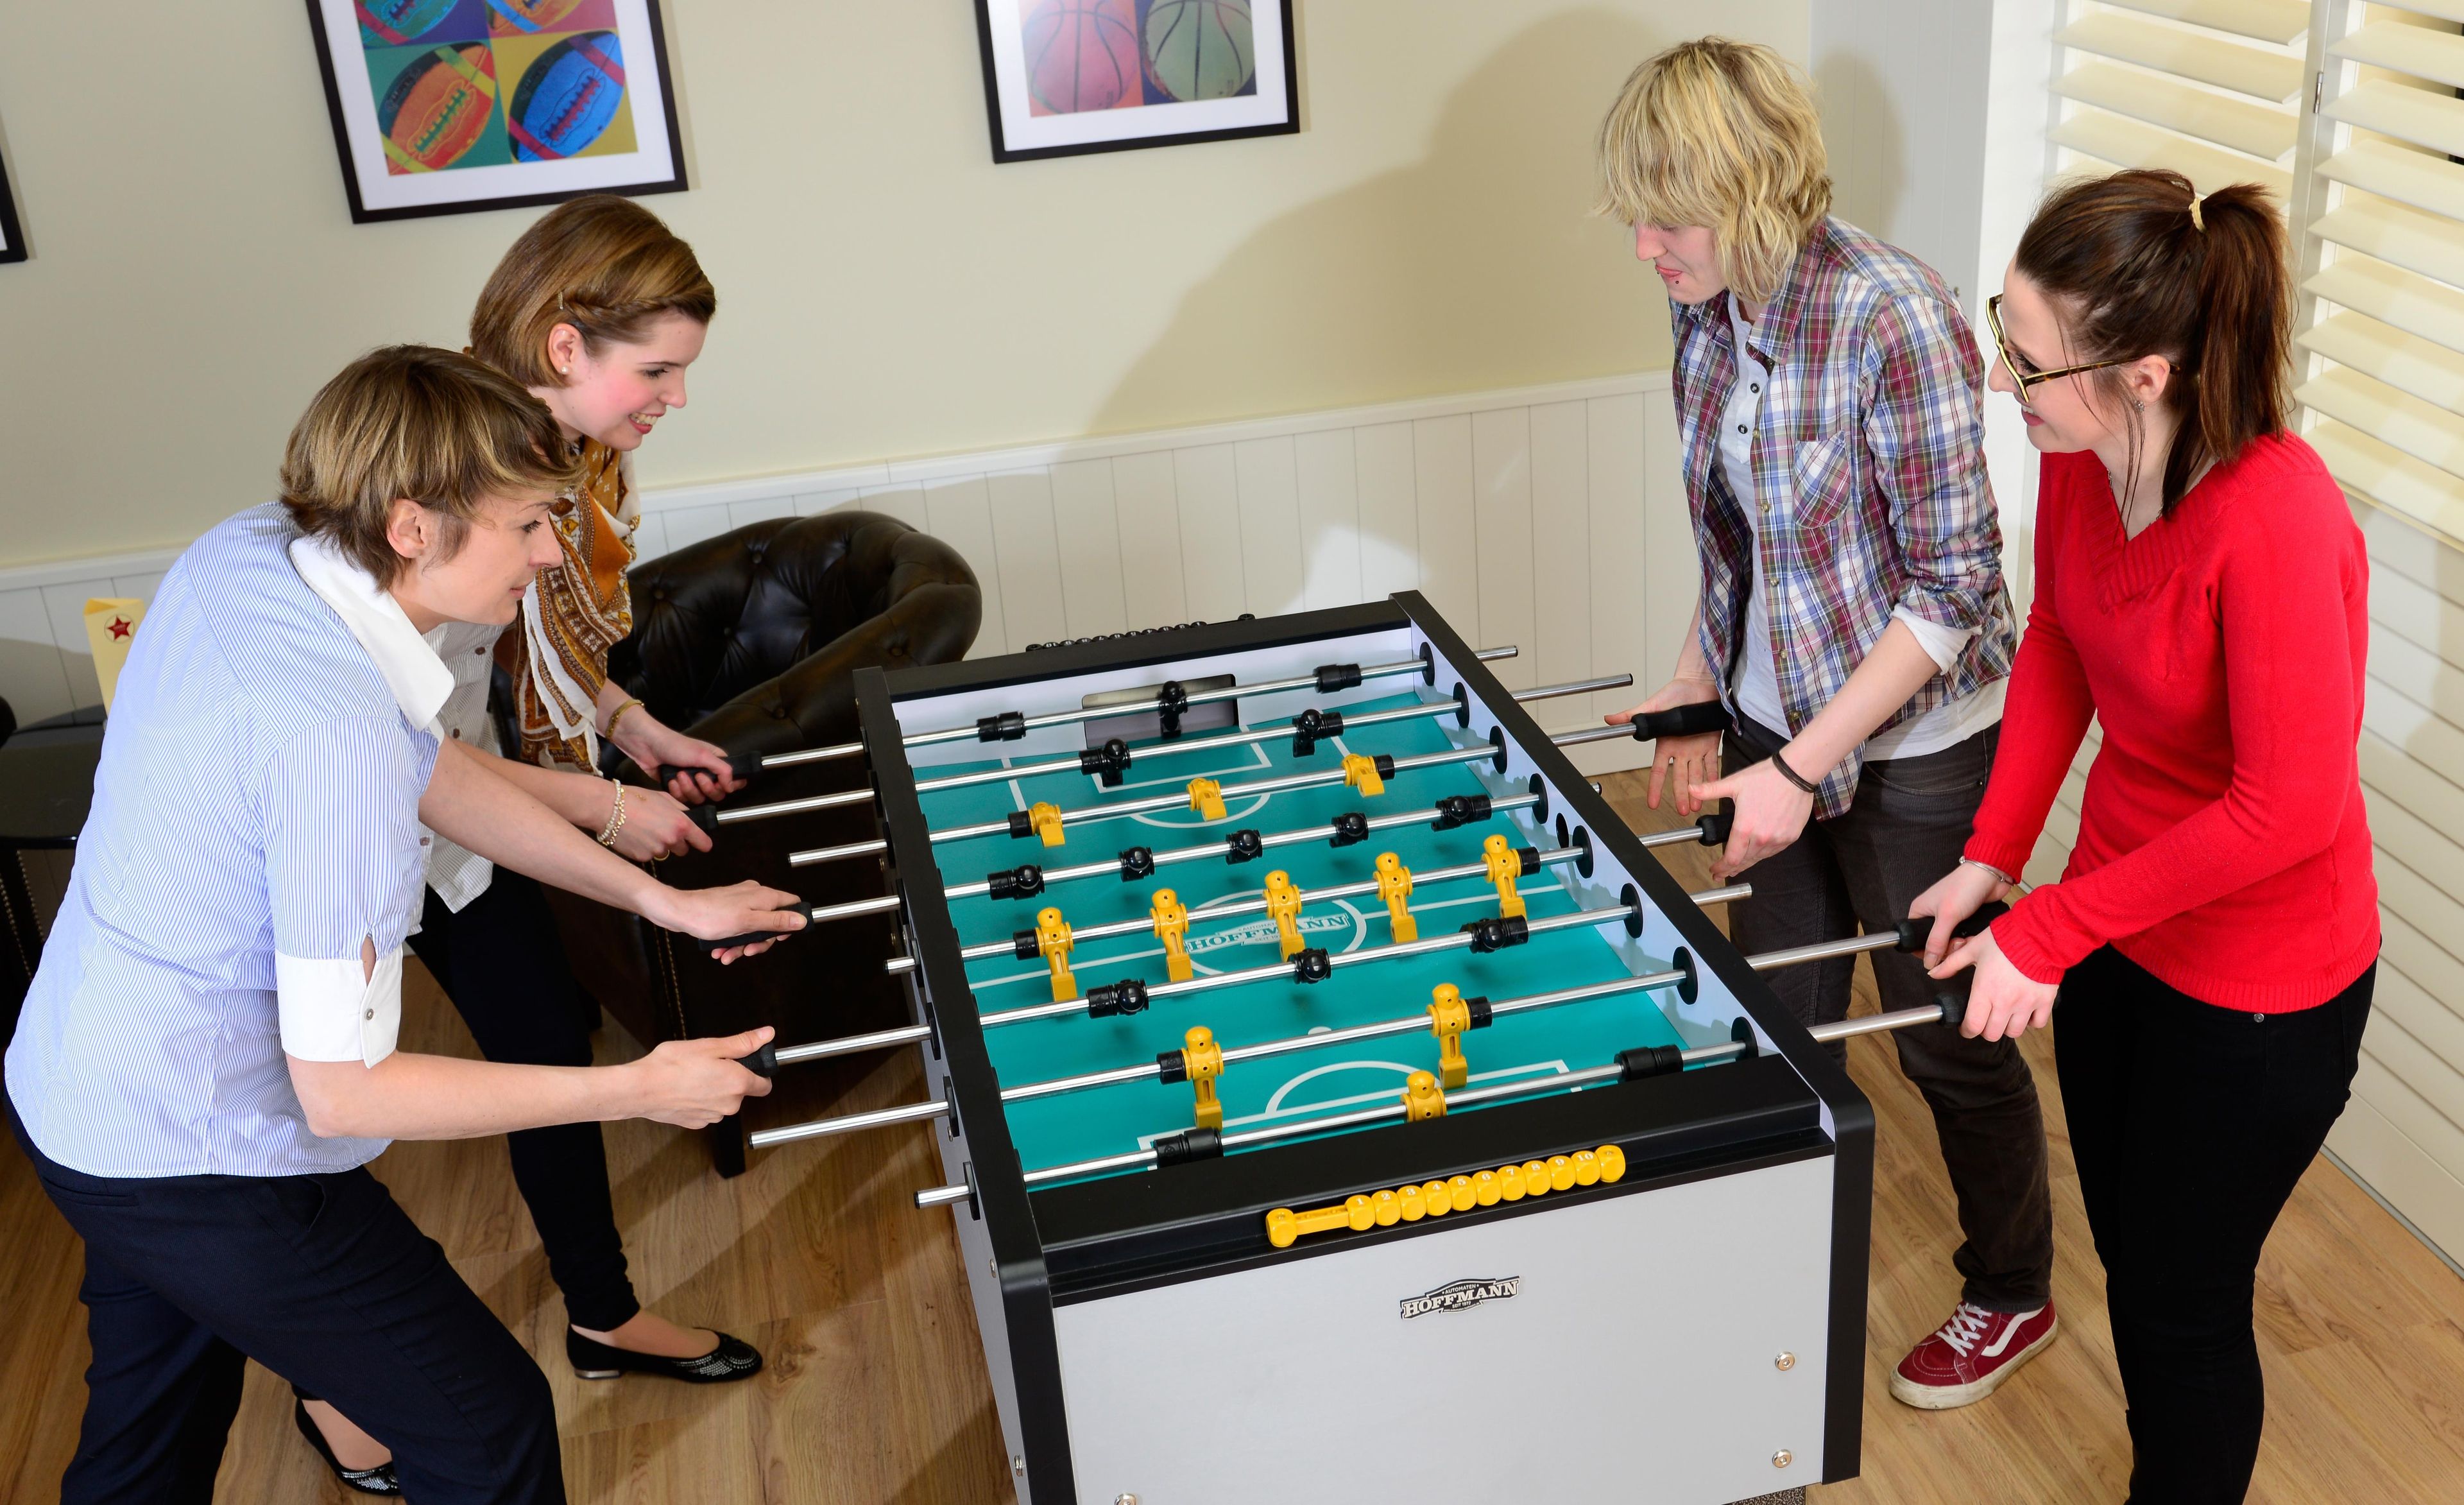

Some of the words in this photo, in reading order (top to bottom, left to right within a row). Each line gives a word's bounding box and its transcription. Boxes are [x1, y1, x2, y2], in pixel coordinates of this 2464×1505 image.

[1381, 1192, 1391, 1201] 2
[1457, 1178, 1467, 1186] 5
[1577, 1153, 1595, 1162] 10
[1403, 1280, 1519, 1318] HOFFMANN
[1444, 1283, 1476, 1294] AUTOMATEN
